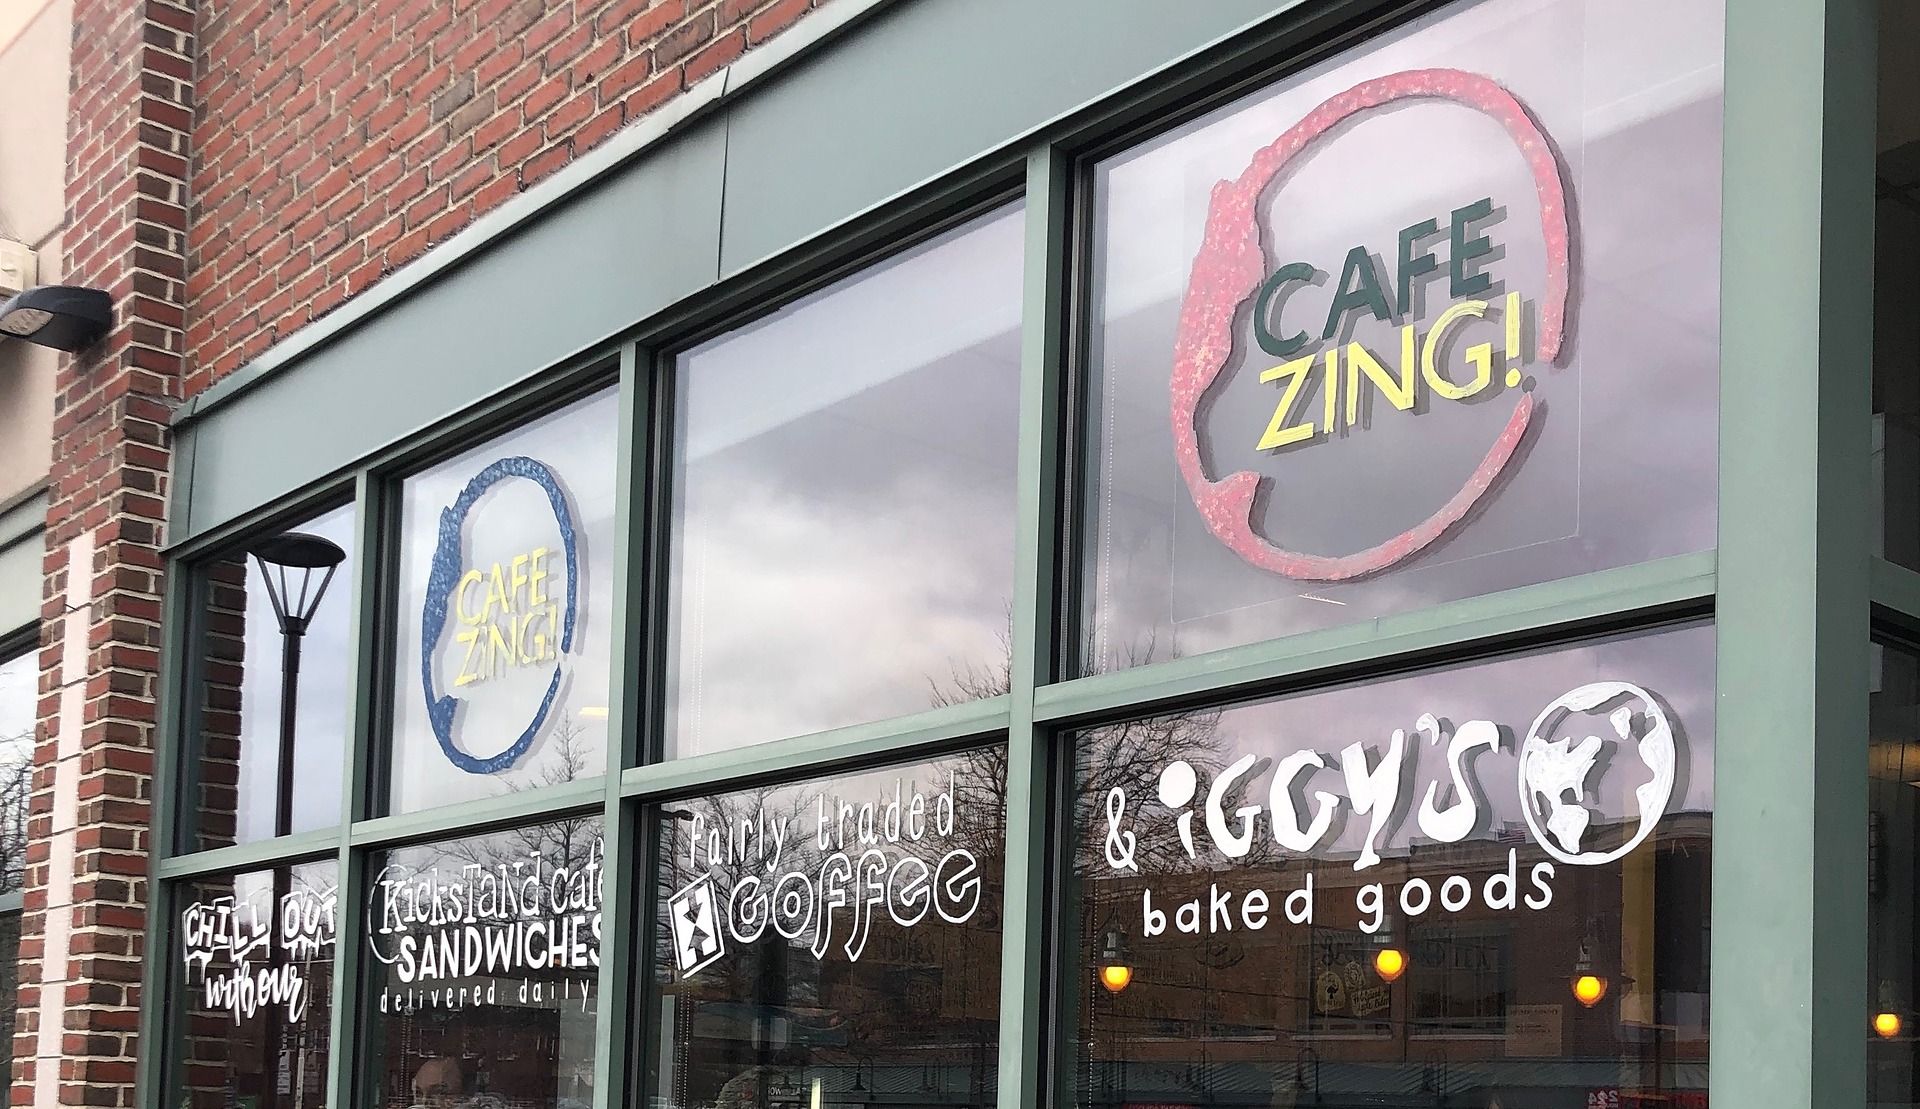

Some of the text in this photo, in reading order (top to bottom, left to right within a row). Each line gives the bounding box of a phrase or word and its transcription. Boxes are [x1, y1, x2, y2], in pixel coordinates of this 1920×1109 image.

[1253, 197, 1491, 357] CAFE
[1255, 290, 1521, 451] ZING!
[456, 547, 548, 626] CAFE
[454, 605, 558, 687] ZING!
[690, 769, 955, 873] fairly traded
[1104, 785, 1138, 874] &
[185, 895, 338, 950] CHILL OUT
[728, 848, 981, 963] coffee
[1141, 847, 1556, 938] baked goods
[396, 912, 602, 983] SANDWICHES
[256, 963, 307, 1024] our
[379, 977, 590, 1014] delivered daily
